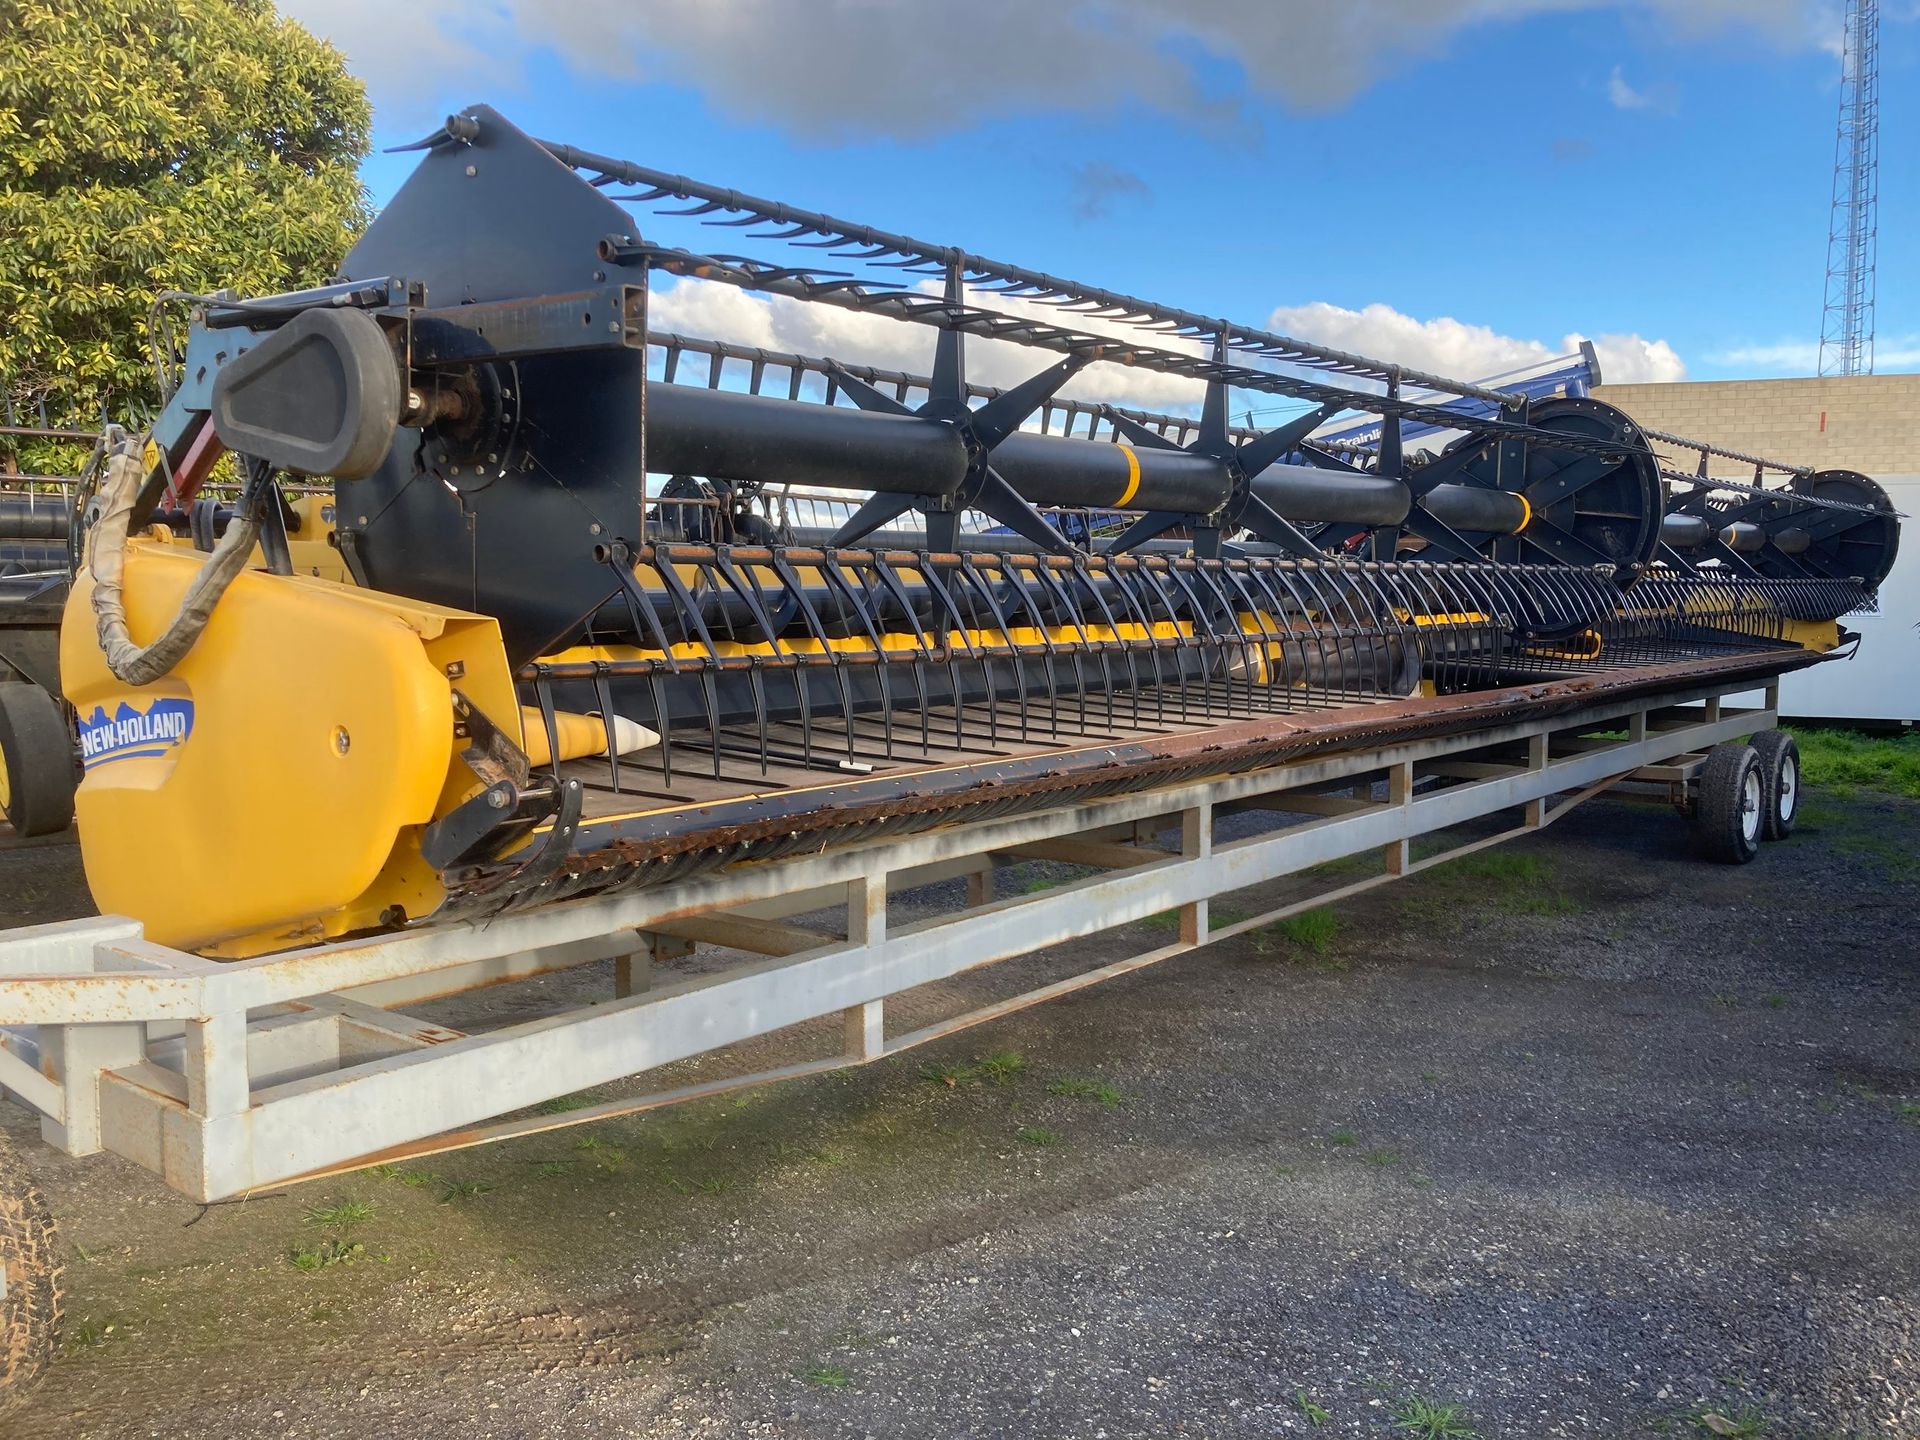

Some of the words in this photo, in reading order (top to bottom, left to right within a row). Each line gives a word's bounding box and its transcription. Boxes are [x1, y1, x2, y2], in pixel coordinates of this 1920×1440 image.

[1335, 428, 1382, 446] Grainli
[81, 723, 115, 757] NEW
[116, 712, 186, 746] HOLLAND
